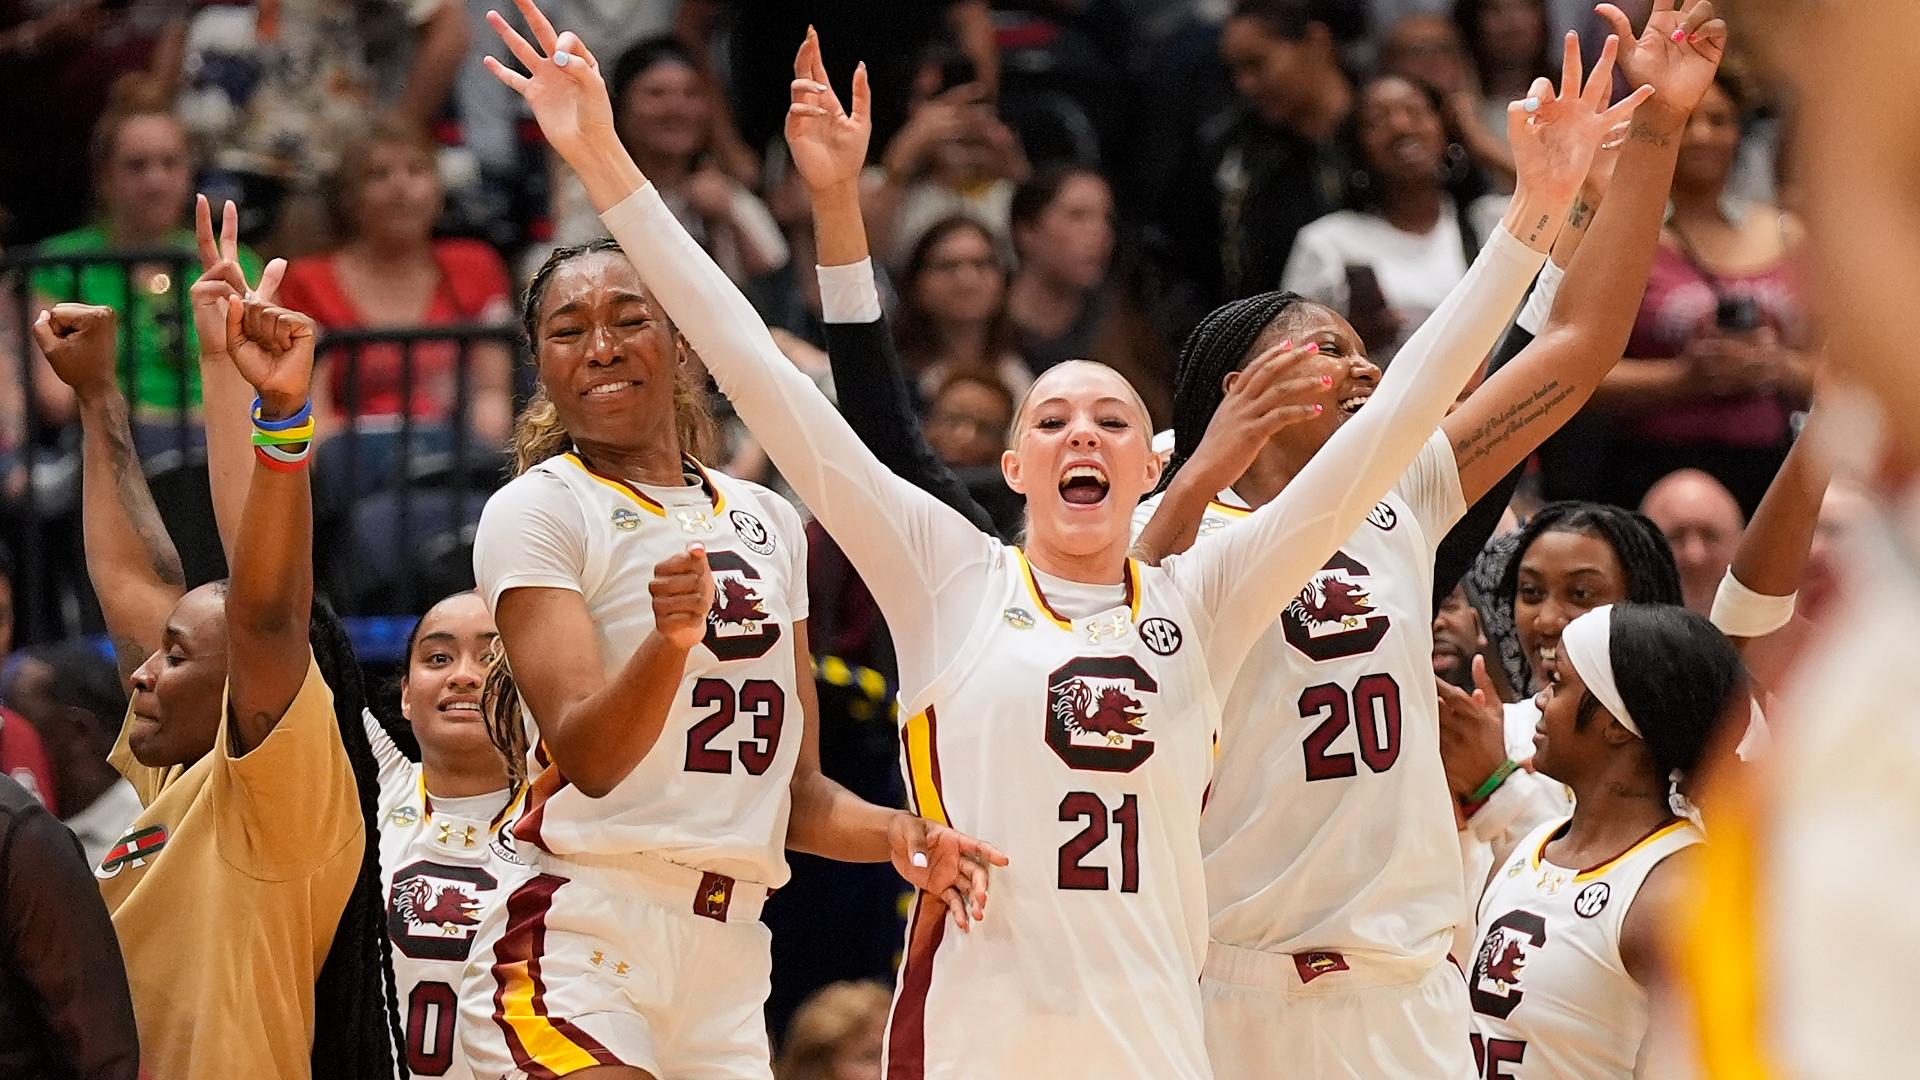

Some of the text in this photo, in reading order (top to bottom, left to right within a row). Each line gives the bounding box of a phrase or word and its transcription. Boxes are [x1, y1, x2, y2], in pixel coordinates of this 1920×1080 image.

[731, 511, 766, 545] SEC
[1140, 618, 1181, 656] SEC
[683, 677, 785, 776] 23
[1297, 672, 1402, 782] 20
[1057, 790, 1139, 893] 21
[1575, 882, 1610, 919] SEC
[407, 980, 458, 1077] 0
